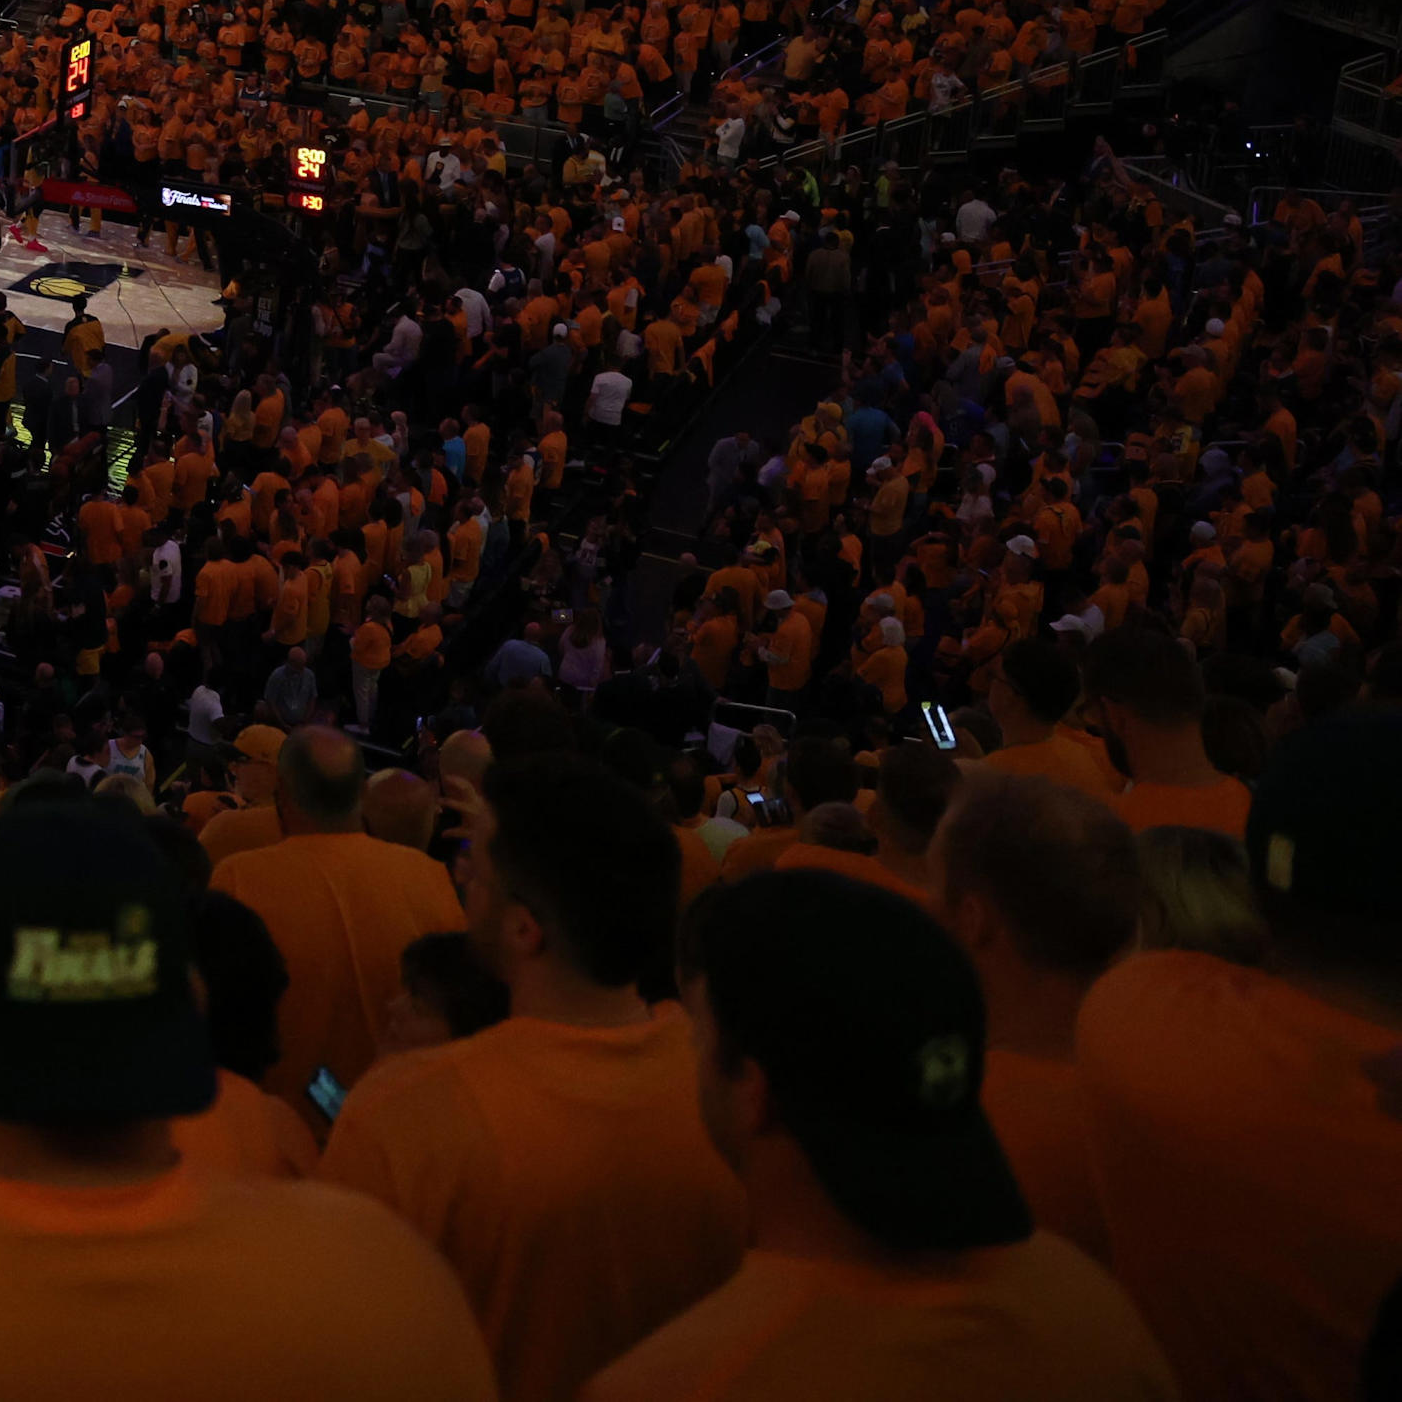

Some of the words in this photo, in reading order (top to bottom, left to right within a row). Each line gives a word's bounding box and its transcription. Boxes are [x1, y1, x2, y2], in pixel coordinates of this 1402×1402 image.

[67, 57, 89, 92] 24
[297, 148, 326, 165] 12:00
[297, 160, 320, 179] 24
[167, 189, 201, 206] Finals
